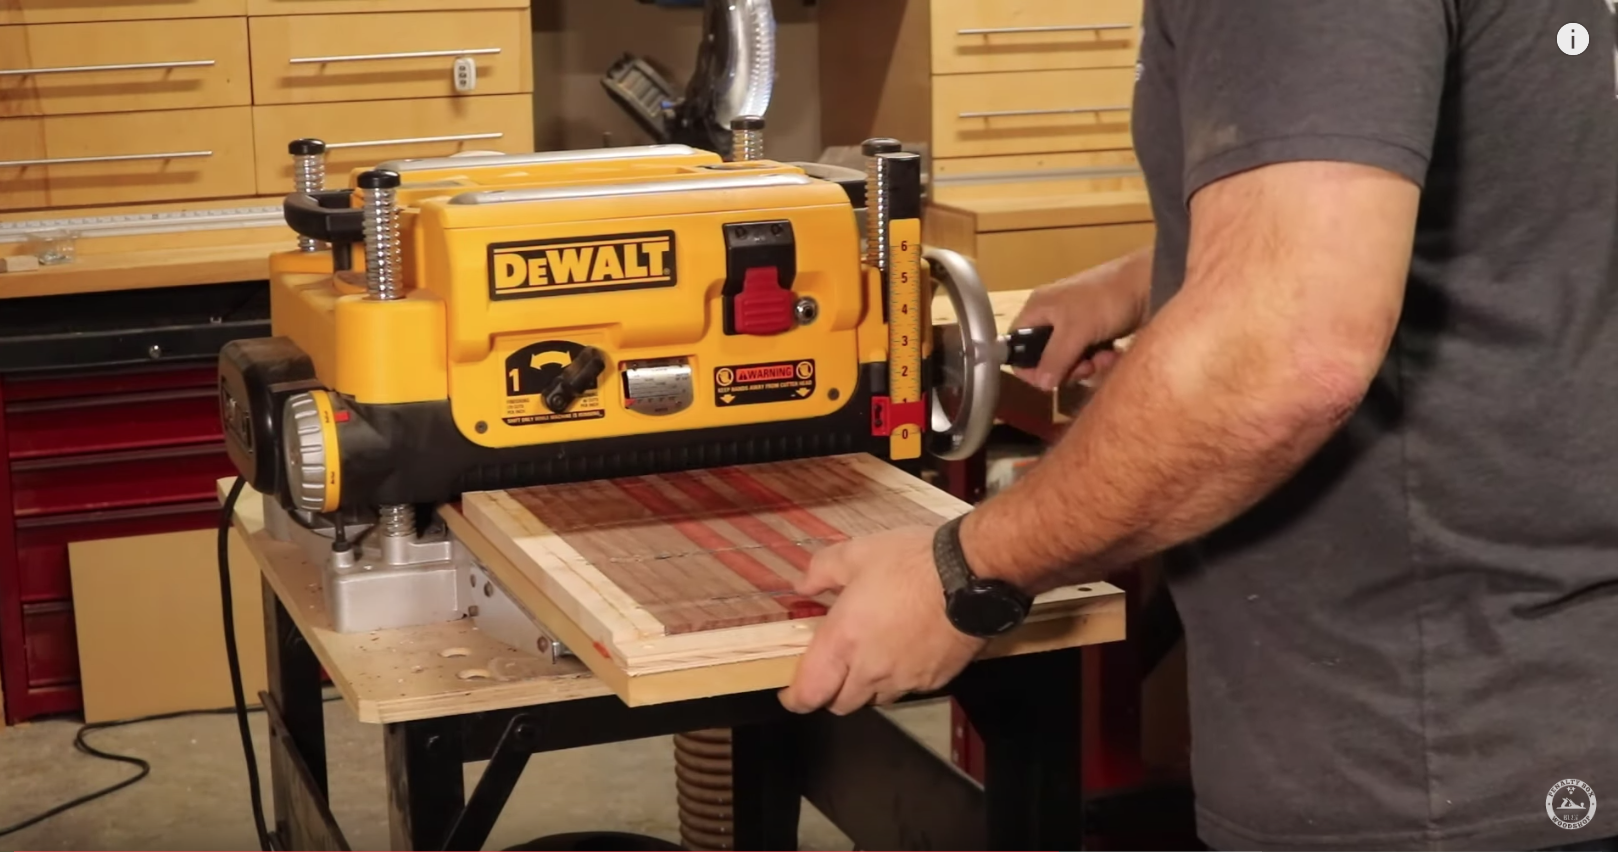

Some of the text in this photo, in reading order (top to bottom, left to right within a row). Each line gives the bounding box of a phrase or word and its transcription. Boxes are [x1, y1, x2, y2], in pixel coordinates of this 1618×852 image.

[901, 240, 908, 252] 6
[901, 271, 908, 284] 5
[901, 303, 908, 315] 4
[901, 335, 908, 346] 3
[747, 366, 792, 379] WARNING
[901, 365, 908, 377] 2
[508, 368, 520, 392] 1
[902, 428, 908, 439] 0
